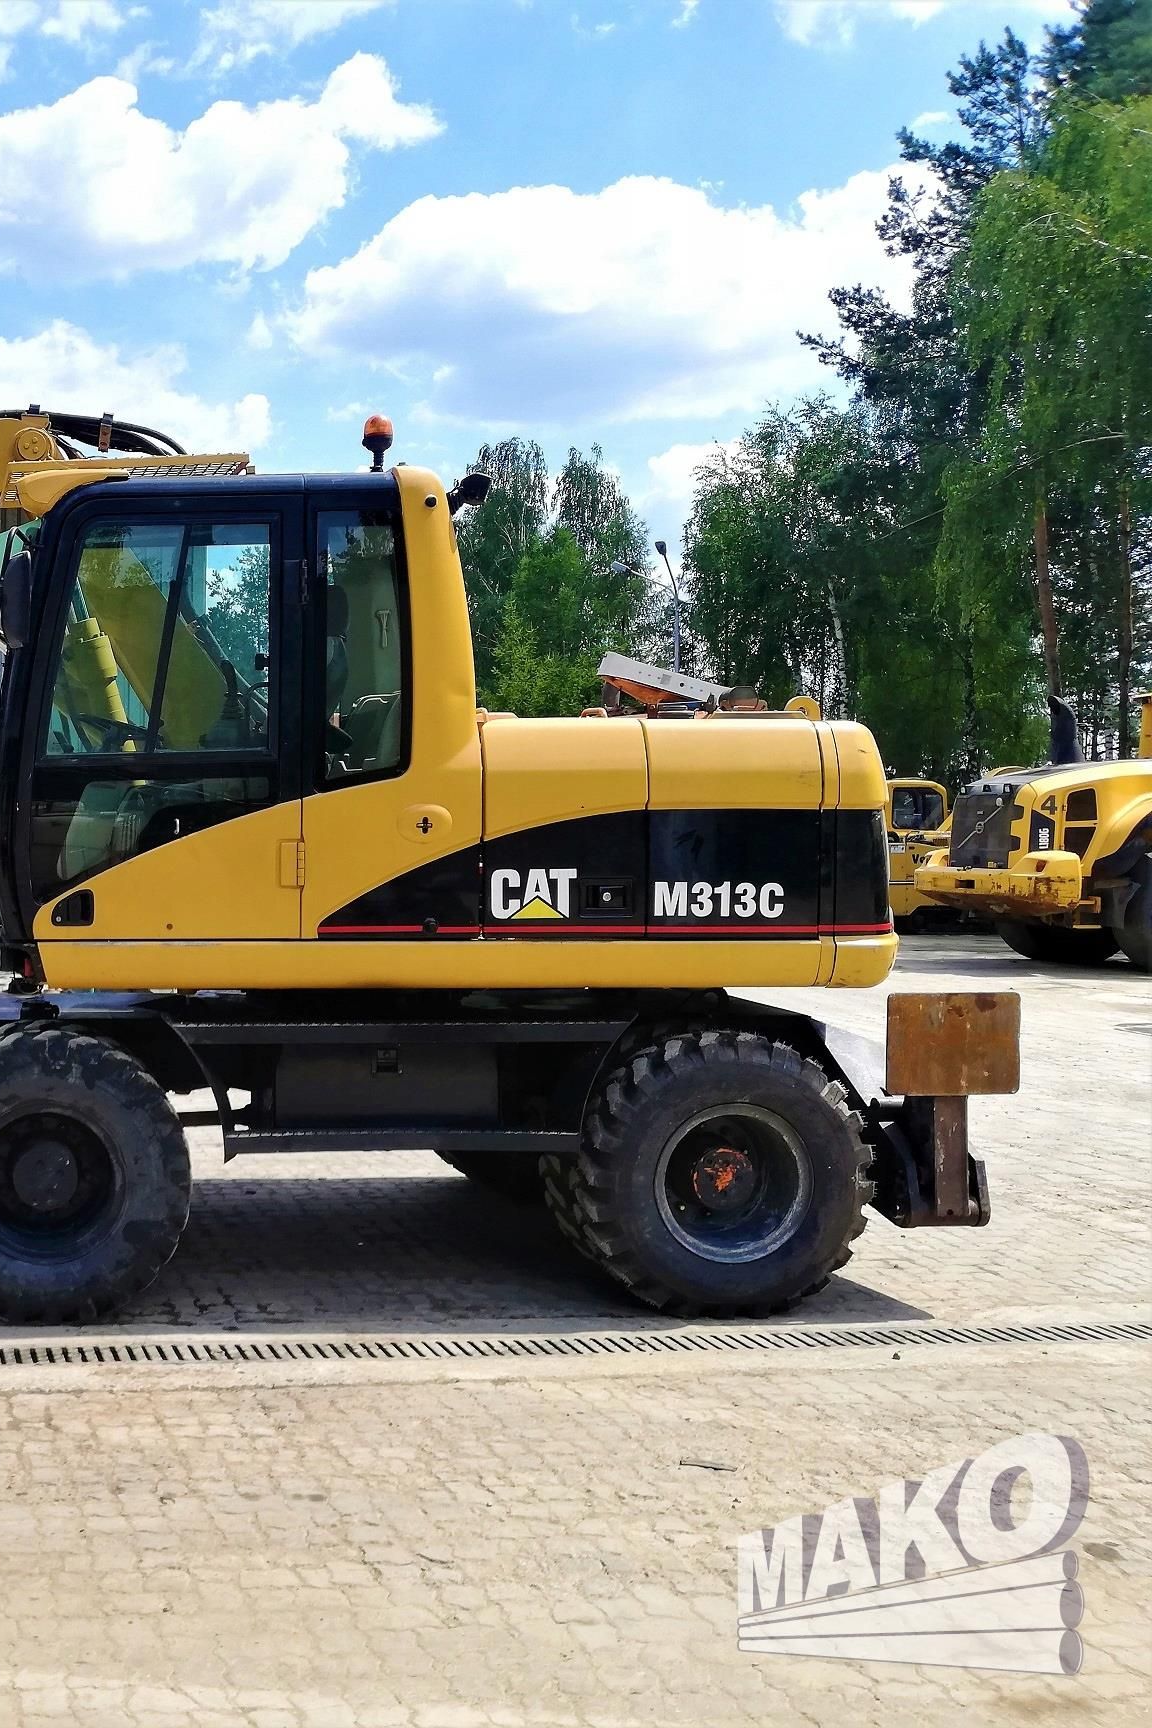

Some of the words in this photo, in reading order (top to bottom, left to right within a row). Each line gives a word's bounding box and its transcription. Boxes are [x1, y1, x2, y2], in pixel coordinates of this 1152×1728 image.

[1041, 795, 1057, 815] 4
[490, 868, 577, 919] CAT
[653, 881, 784, 918] M313C
